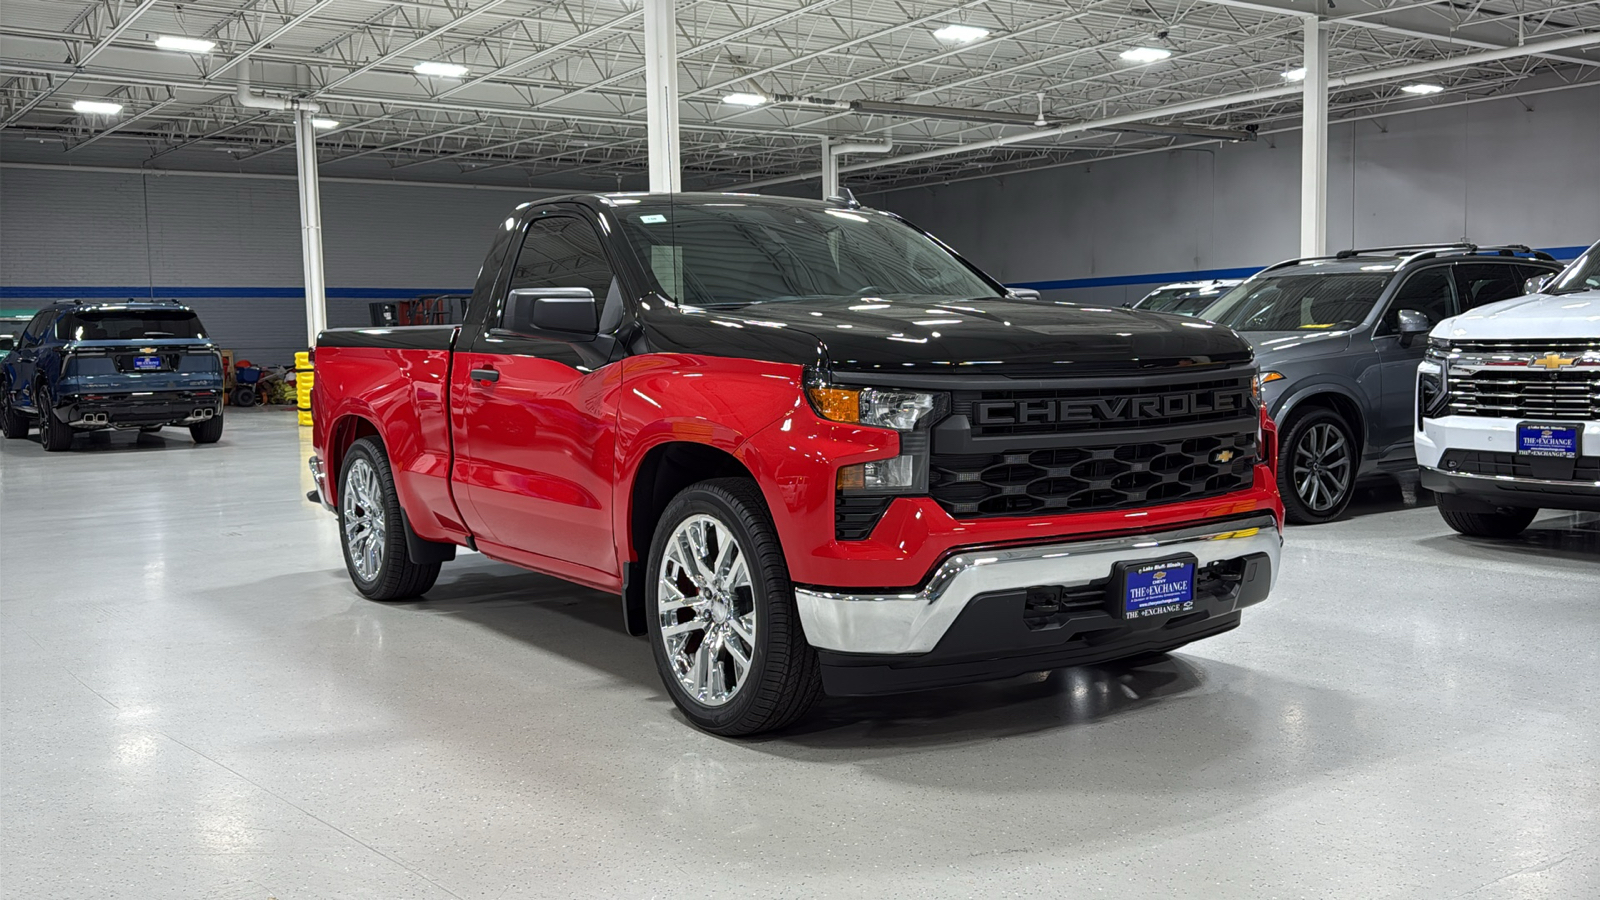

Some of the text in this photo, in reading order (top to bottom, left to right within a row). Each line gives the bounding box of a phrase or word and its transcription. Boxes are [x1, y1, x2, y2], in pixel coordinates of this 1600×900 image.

[977, 389, 1250, 424] CHEVROLET
[1538, 438, 1572, 446] EXCHANGE
[1130, 580, 1188, 598] THE EXCHANGE
[1126, 604, 1180, 619] THE EXCHANGE
